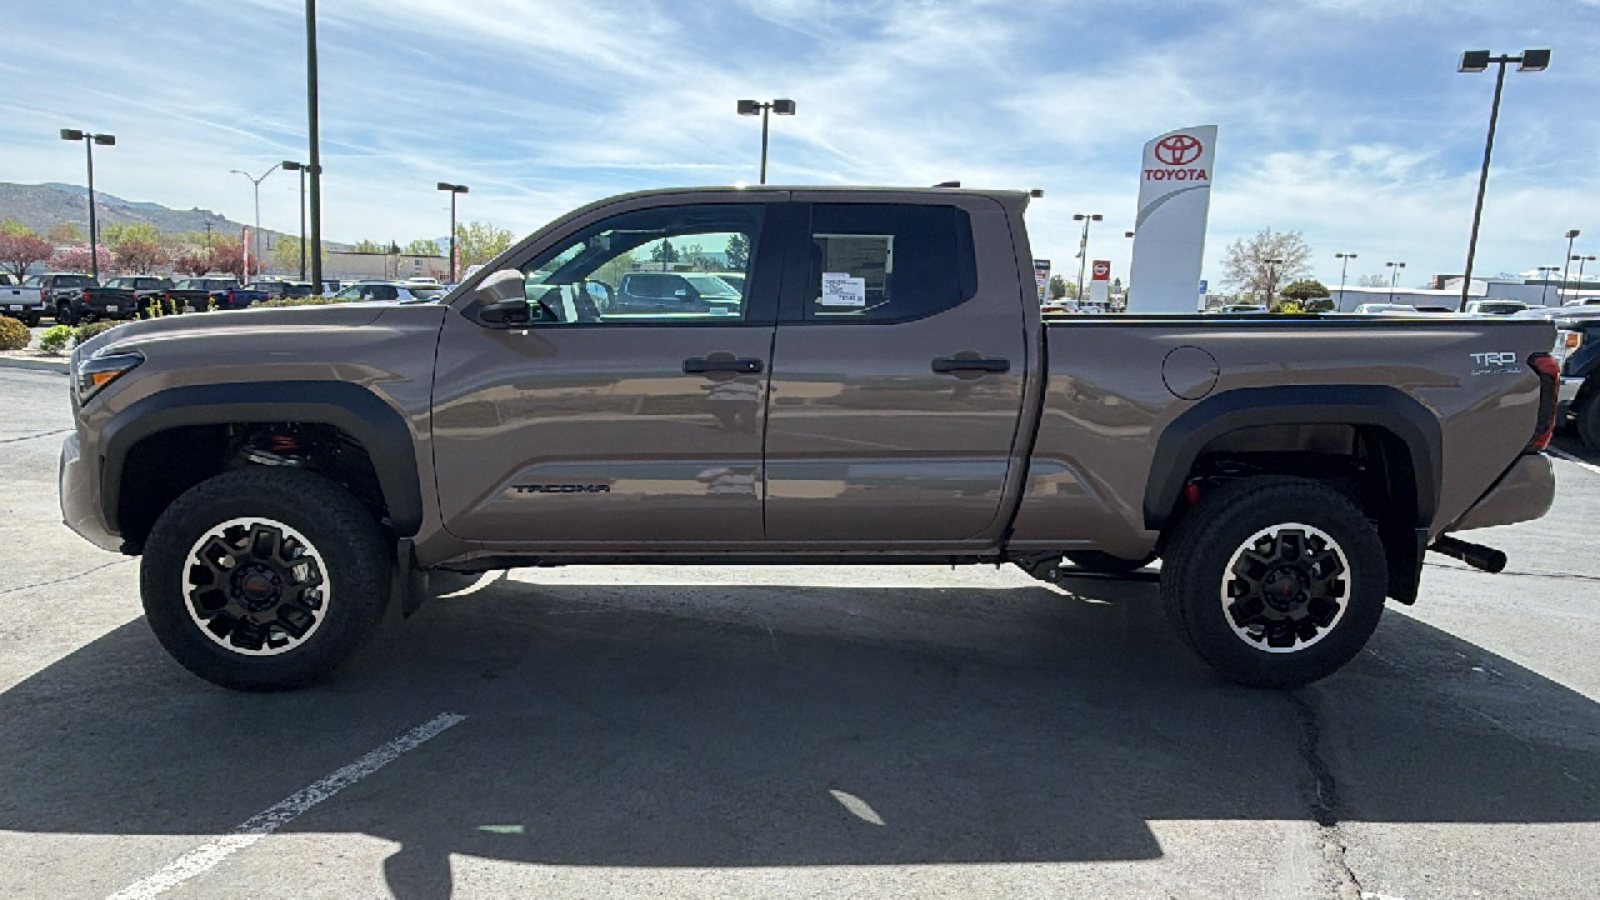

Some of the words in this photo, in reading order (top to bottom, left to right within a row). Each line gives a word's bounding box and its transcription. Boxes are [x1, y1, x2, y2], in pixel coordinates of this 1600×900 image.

[1144, 168, 1208, 181] TOYOTA
[1469, 351, 1516, 367] TRD
[510, 484, 611, 494] TACOMA
